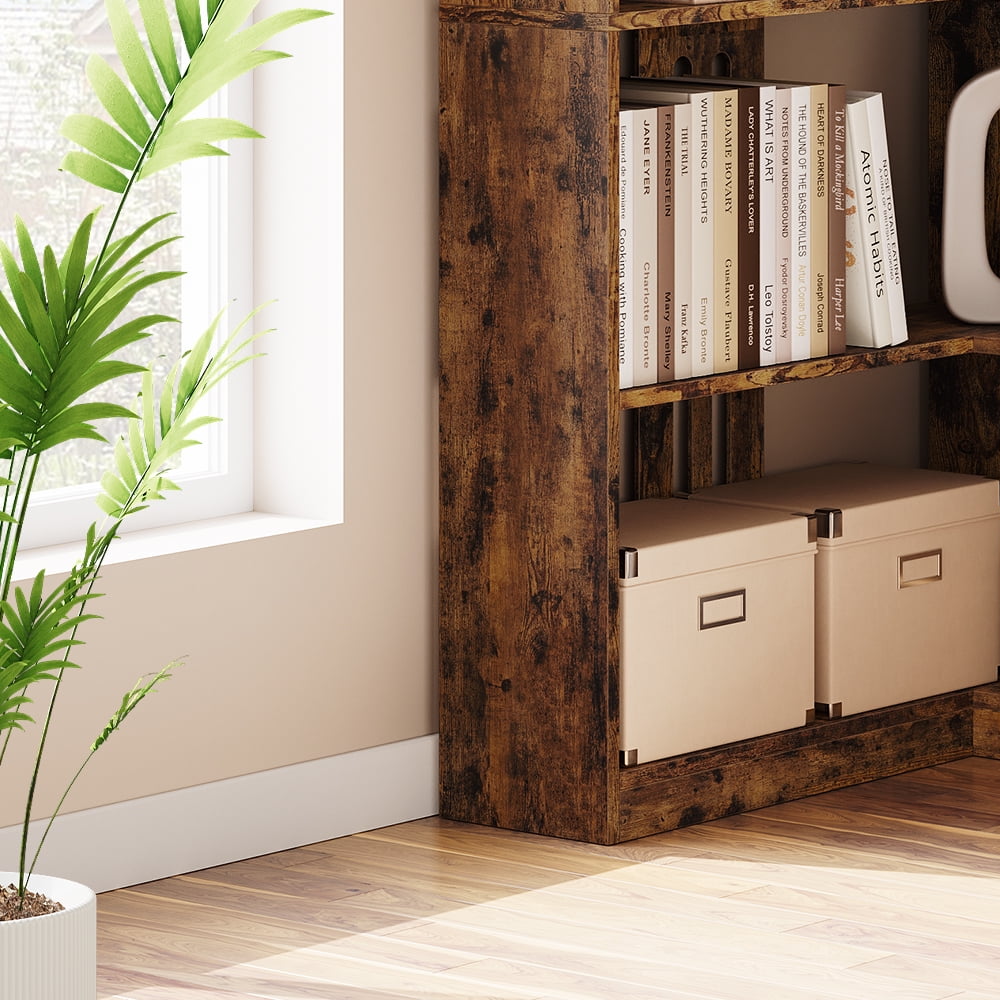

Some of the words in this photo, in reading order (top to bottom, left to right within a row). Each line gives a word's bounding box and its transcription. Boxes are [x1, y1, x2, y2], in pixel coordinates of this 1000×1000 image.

[764, 100, 774, 138] WHAT
[798, 105, 806, 122] THE
[835, 109, 844, 122] To
[724, 98, 732, 158] MADAME
[798, 124, 806, 156] HOUND
[817, 135, 824, 147] OF
[835, 124, 844, 142] Kill
[764, 142, 774, 154] IS
[764, 158, 774, 183] ART
[798, 159, 806, 170] OF
[724, 162, 732, 214] BOVARY
[798, 174, 806, 190] THE
[832, 154, 844, 210] Mockingbird
[798, 193, 806, 257] BASKERVILLES
[861, 150, 876, 223] Atomic
[870, 231, 883, 298] Habits
[882, 160, 890, 192] NOSE
[886, 195, 892, 210] TO
[892, 242, 900, 285] EATING
[724, 259, 732, 307] Gustave
[780, 258, 788, 285] Fyodor
[764, 285, 774, 306] Leo
[798, 287, 806, 312] Conan
[816, 273, 824, 301] Joseph
[832, 278, 844, 311] Harper
[699, 298, 708, 326] Emily
[797, 316, 806, 336] Doyle
[834, 314, 844, 330] Lee
[724, 312, 732, 362] Flaubert
[762, 311, 774, 352] Tolstoy
